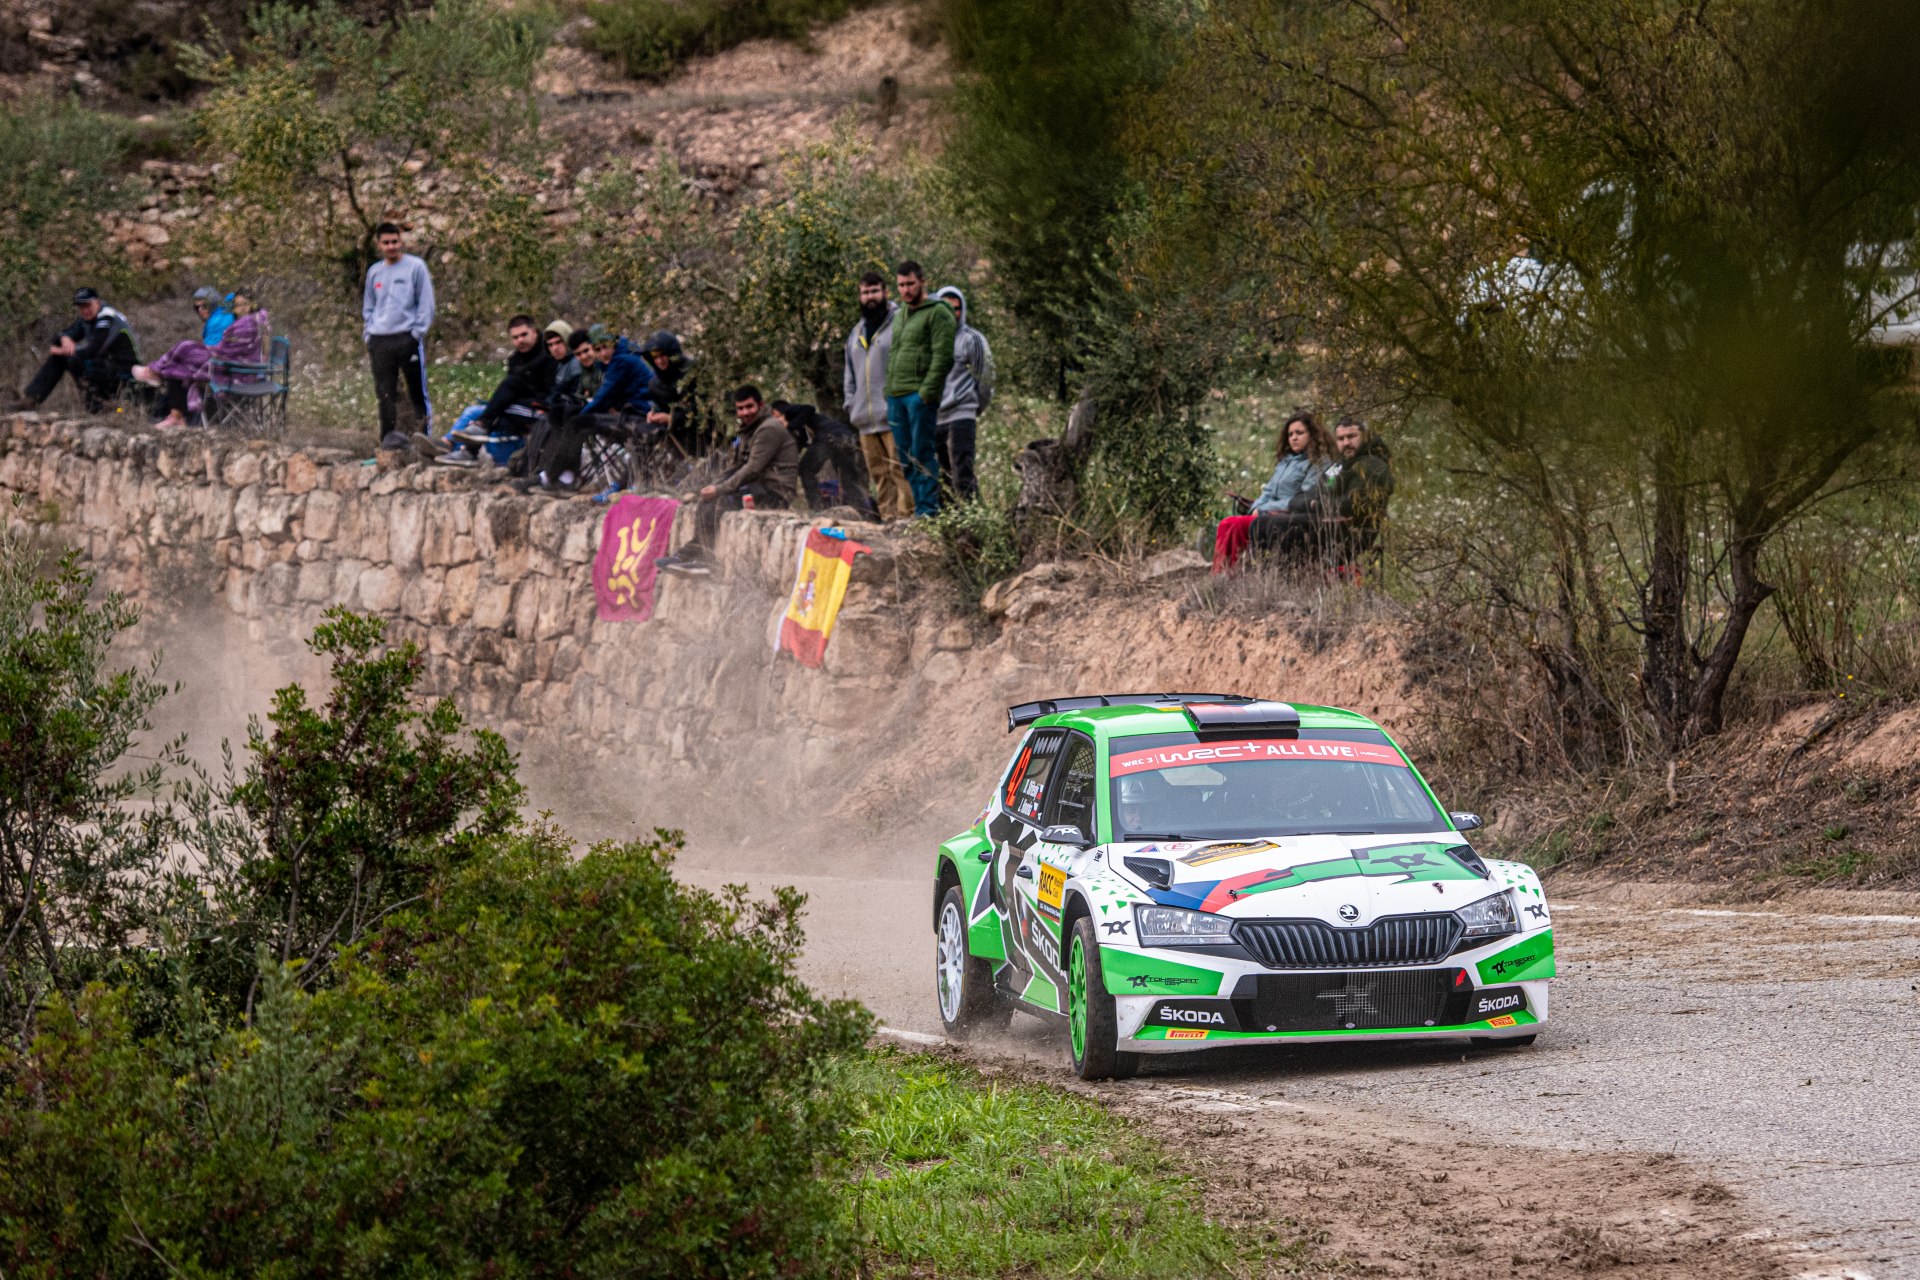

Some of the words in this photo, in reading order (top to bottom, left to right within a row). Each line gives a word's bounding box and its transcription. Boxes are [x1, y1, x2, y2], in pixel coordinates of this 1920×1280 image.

[1122, 759, 1144, 768] WRC
[1266, 744, 1304, 755] ALL
[1308, 745, 1354, 756] LIVE
[1039, 870, 1054, 896] RACC
[1478, 994, 1518, 1012] ŠKODA
[1160, 1006, 1224, 1024] ŠKODA
